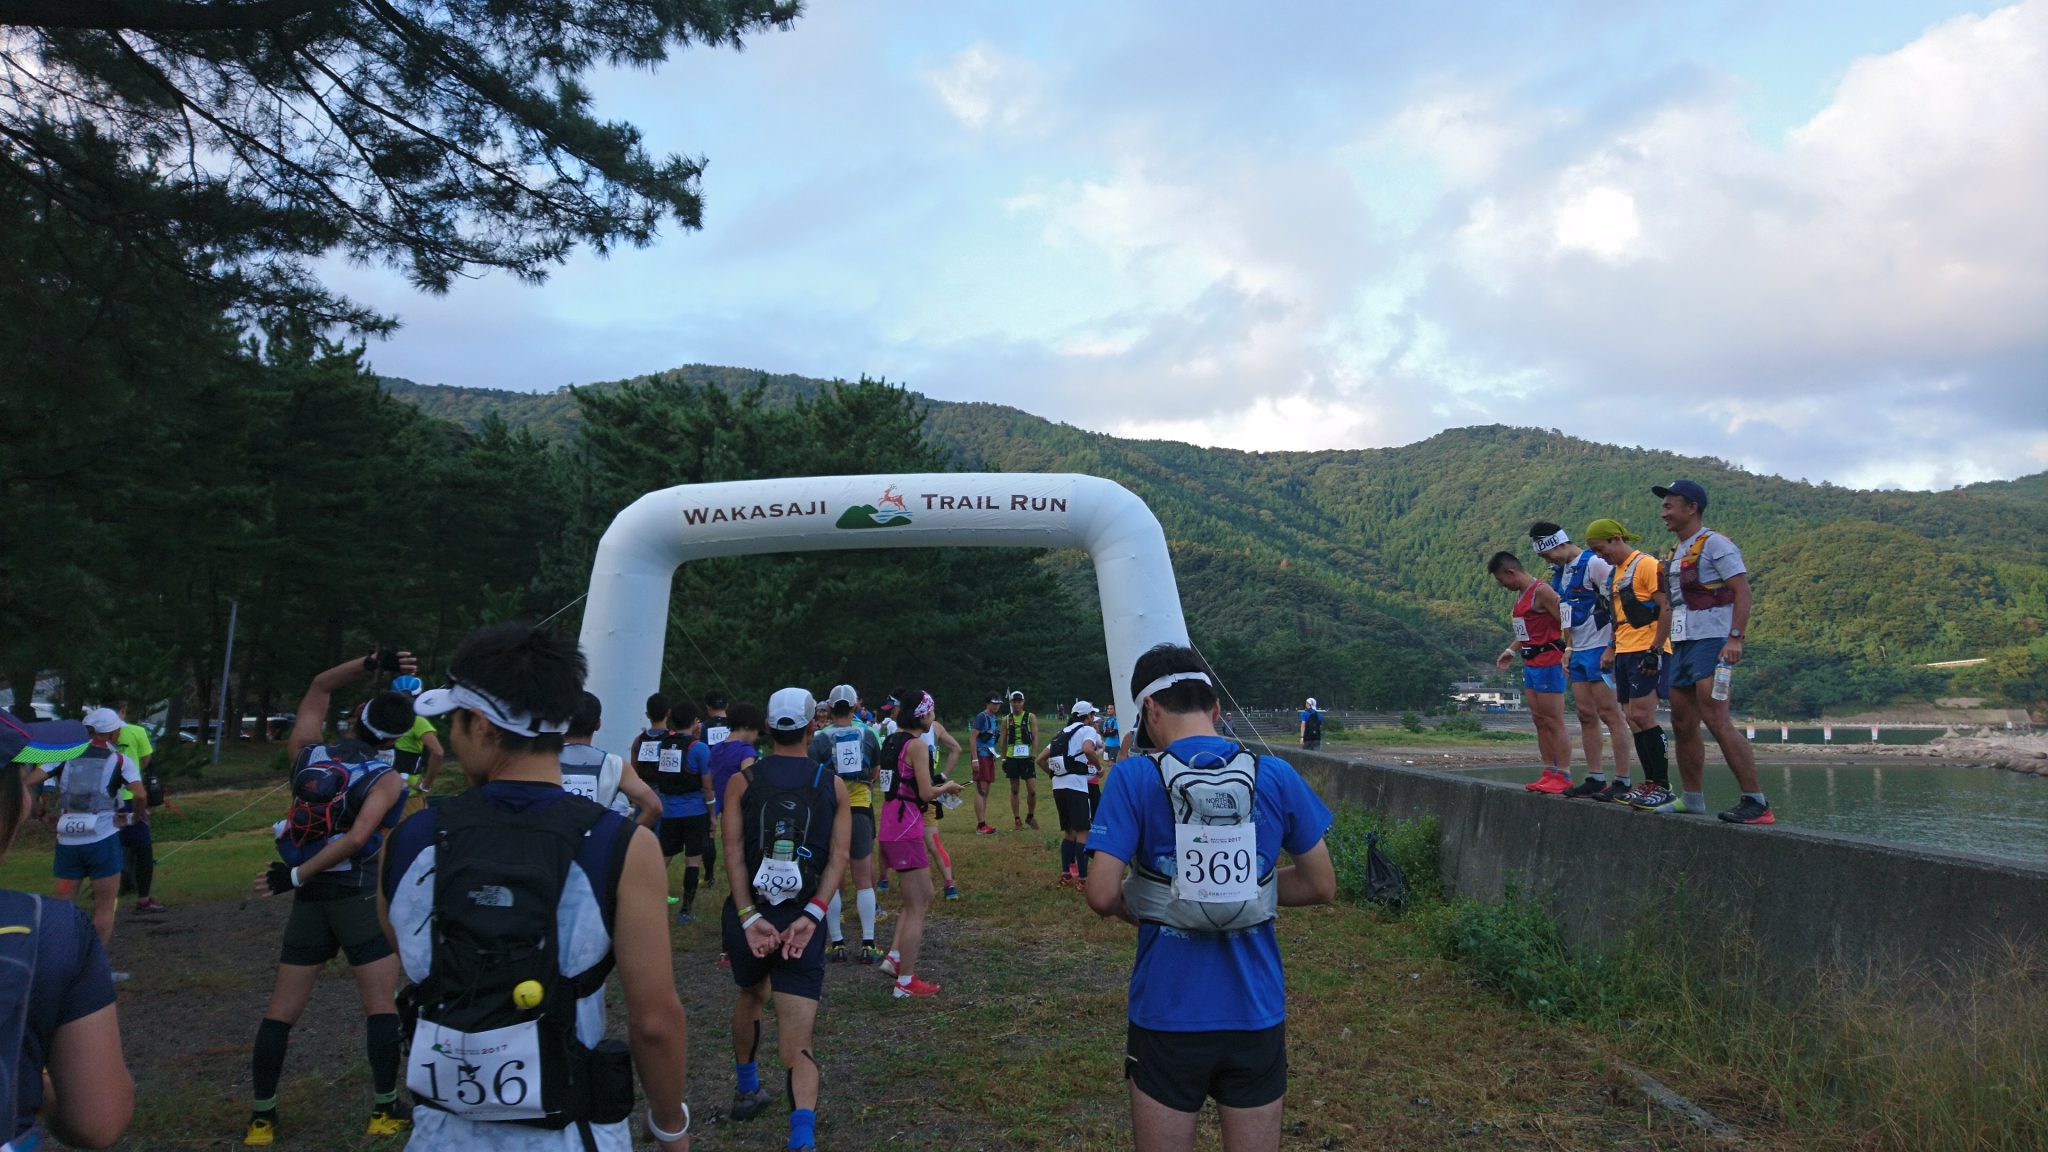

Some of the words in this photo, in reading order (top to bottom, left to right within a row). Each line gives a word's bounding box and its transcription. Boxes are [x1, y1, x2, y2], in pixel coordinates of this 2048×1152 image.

[921, 494, 1000, 510] TRAIL
[1010, 494, 1066, 512] RUN
[683, 501, 826, 525] WAKASAJI
[843, 748, 855, 766] 48
[1016, 746, 1026, 754] 67
[660, 756, 679, 768] 358
[65, 821, 85, 833] 69
[1185, 849, 1251, 885] 369
[757, 873, 798, 897] 382
[481, 1044, 508, 1055] 2017
[420, 1060, 528, 1106] 156
